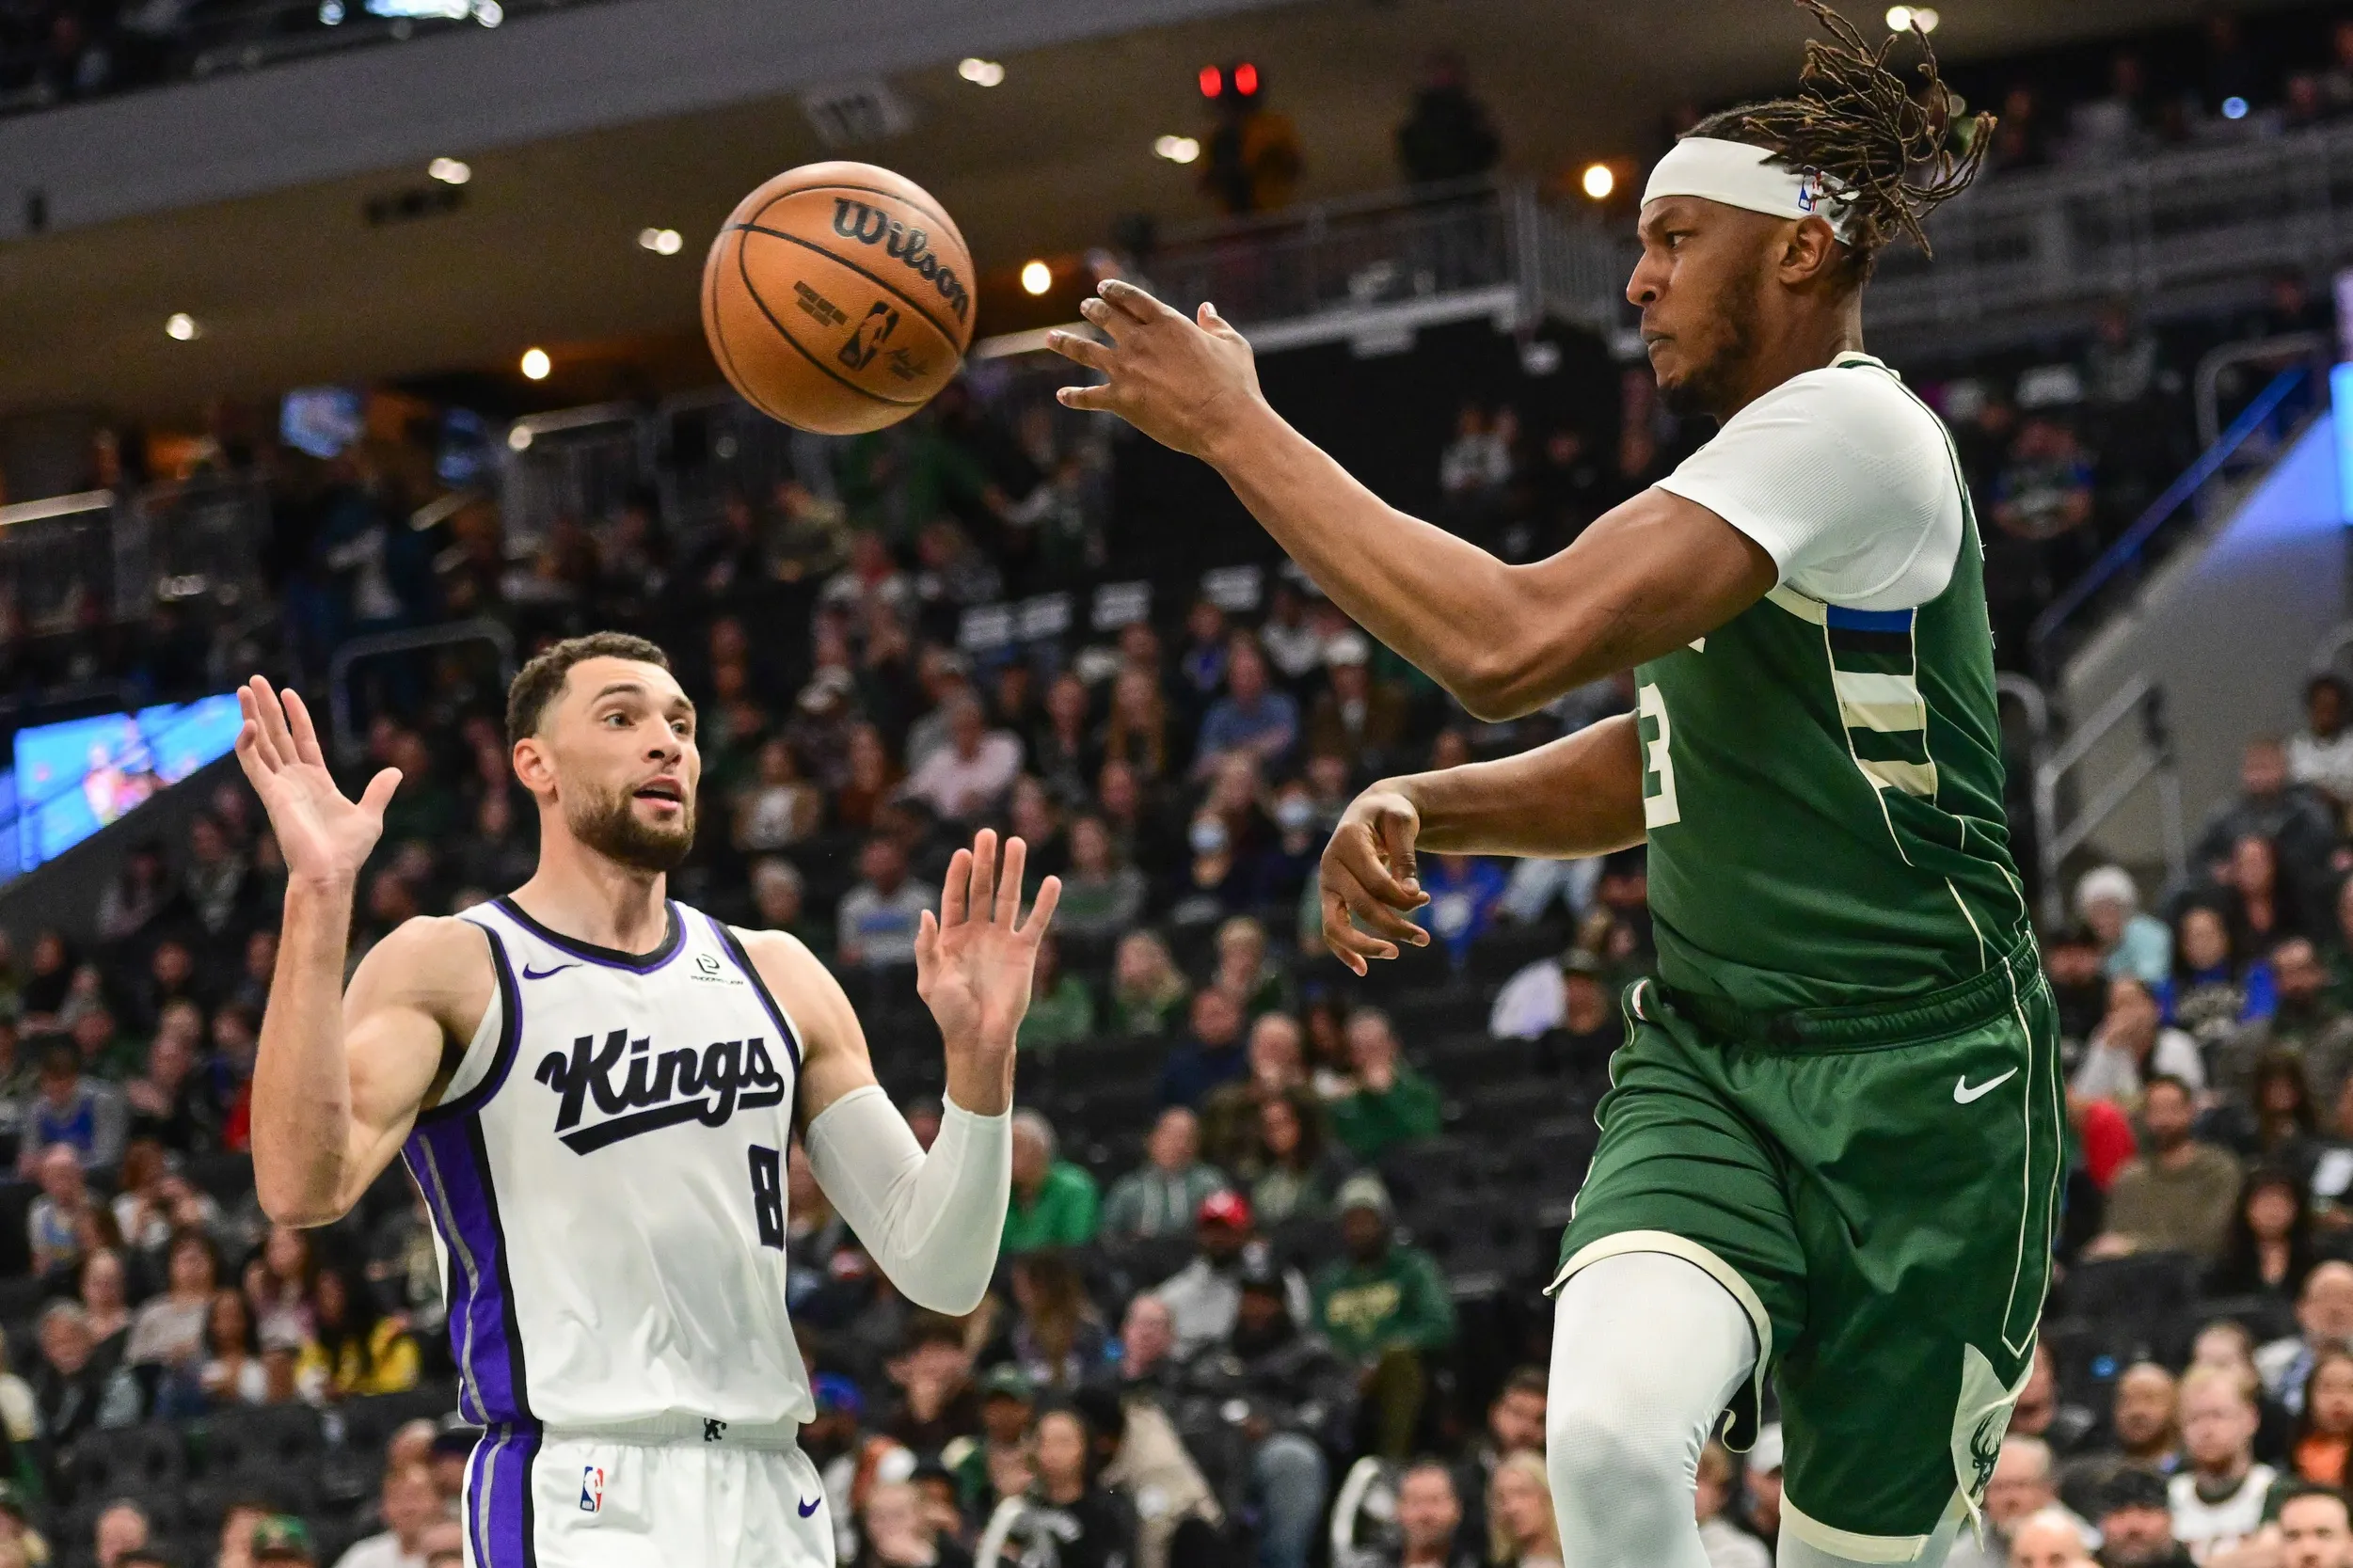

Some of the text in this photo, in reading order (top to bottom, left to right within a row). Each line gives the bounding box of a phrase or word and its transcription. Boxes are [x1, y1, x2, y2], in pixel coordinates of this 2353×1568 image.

[834, 196, 969, 326] Wilson
[1638, 682, 1681, 830] 3
[533, 1027, 785, 1157] Kings
[747, 1143, 786, 1252] 8
